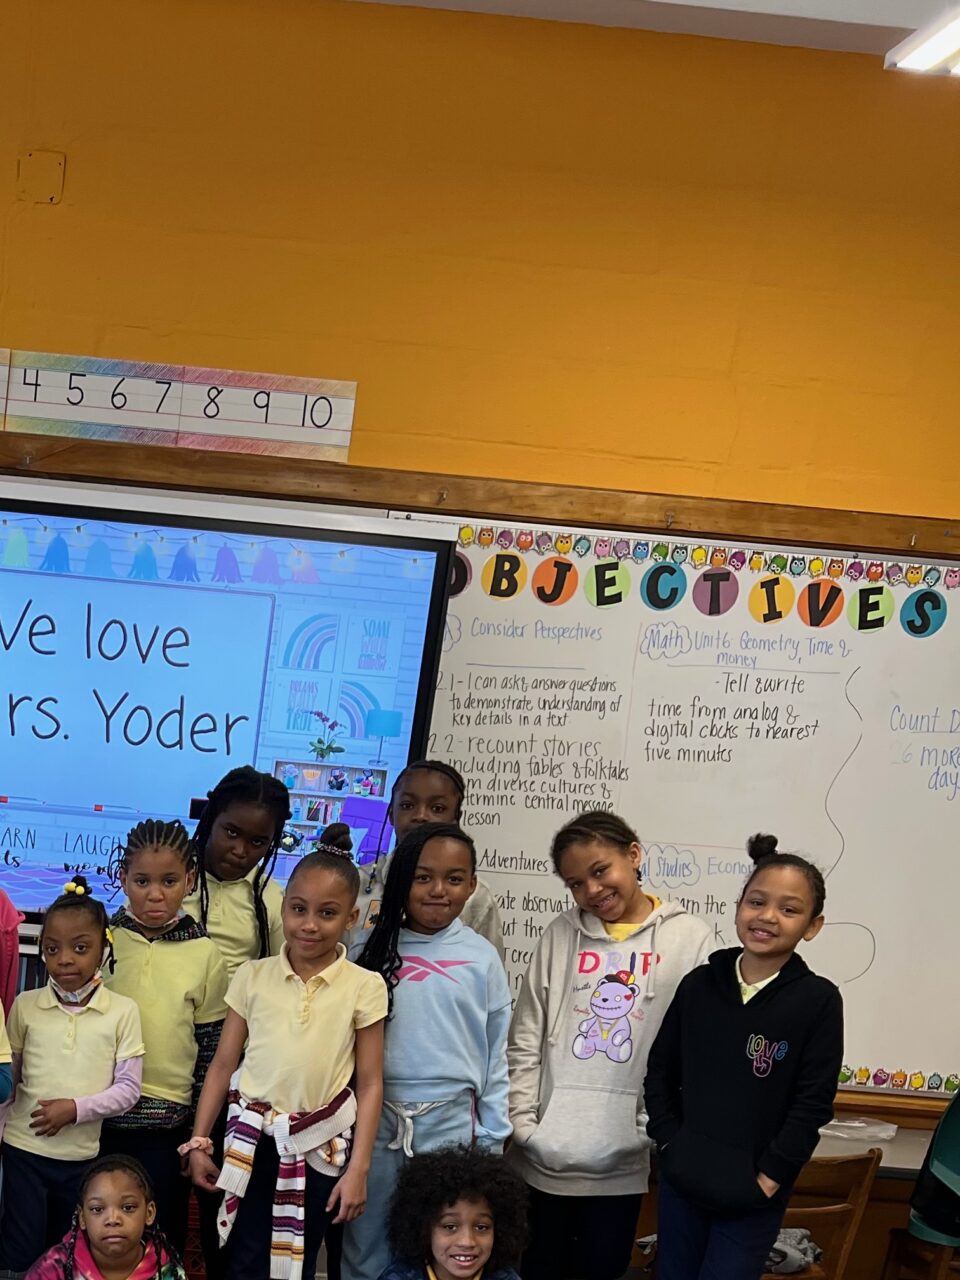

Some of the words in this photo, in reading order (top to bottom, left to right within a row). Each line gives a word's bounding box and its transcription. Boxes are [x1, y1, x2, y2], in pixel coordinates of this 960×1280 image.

[22, 368, 42, 402] 4
[66, 373, 87, 405] 5
[111, 377, 128, 410] 6
[155, 380, 172, 413] 7
[203, 386, 224, 418] 8
[253, 390, 271, 424] 9
[301, 394, 333, 428] 10
[85, 602, 190, 668] love
[471, 617, 528, 639] Consider
[534, 620, 602, 644] Perspectives
[647, 629, 685, 650] Math
[806, 637, 834, 656] Time
[716, 652, 757, 669] money
[474, 675, 497, 691] can
[501, 674, 519, 690] ask
[531, 677, 568, 692] answer
[569, 676, 617, 696] questions
[763, 673, 805, 694] write
[449, 693, 461, 711] to
[463, 693, 534, 711] demonstrate
[610, 694, 623, 713] of
[648, 698, 682, 718] time
[690, 696, 726, 719] from
[733, 701, 780, 727] analog
[92, 687, 250, 756] Yoder
[475, 711, 513, 726] details
[533, 714, 542, 727] a
[546, 712, 569, 727] text
[890, 705, 940, 733] Count
[468, 733, 539, 754] recount
[644, 719, 693, 745] digital
[699, 719, 738, 739] clocks
[746, 722, 760, 739] to
[766, 719, 820, 740] nearest
[644, 741, 672, 763] five
[677, 746, 733, 763] minutes
[527, 755, 564, 778] fables
[580, 758, 630, 781] folktales
[486, 773, 536, 793] diverse
[540, 779, 596, 796] cultures
[928, 766, 960, 801] day
[525, 795, 569, 812] central
[64, 831, 122, 857] LAUGH
[478, 848, 549, 872] Adventures
[655, 857, 693, 878] Studies
[704, 894, 727, 915] the
[578, 951, 662, 976] DRIP
